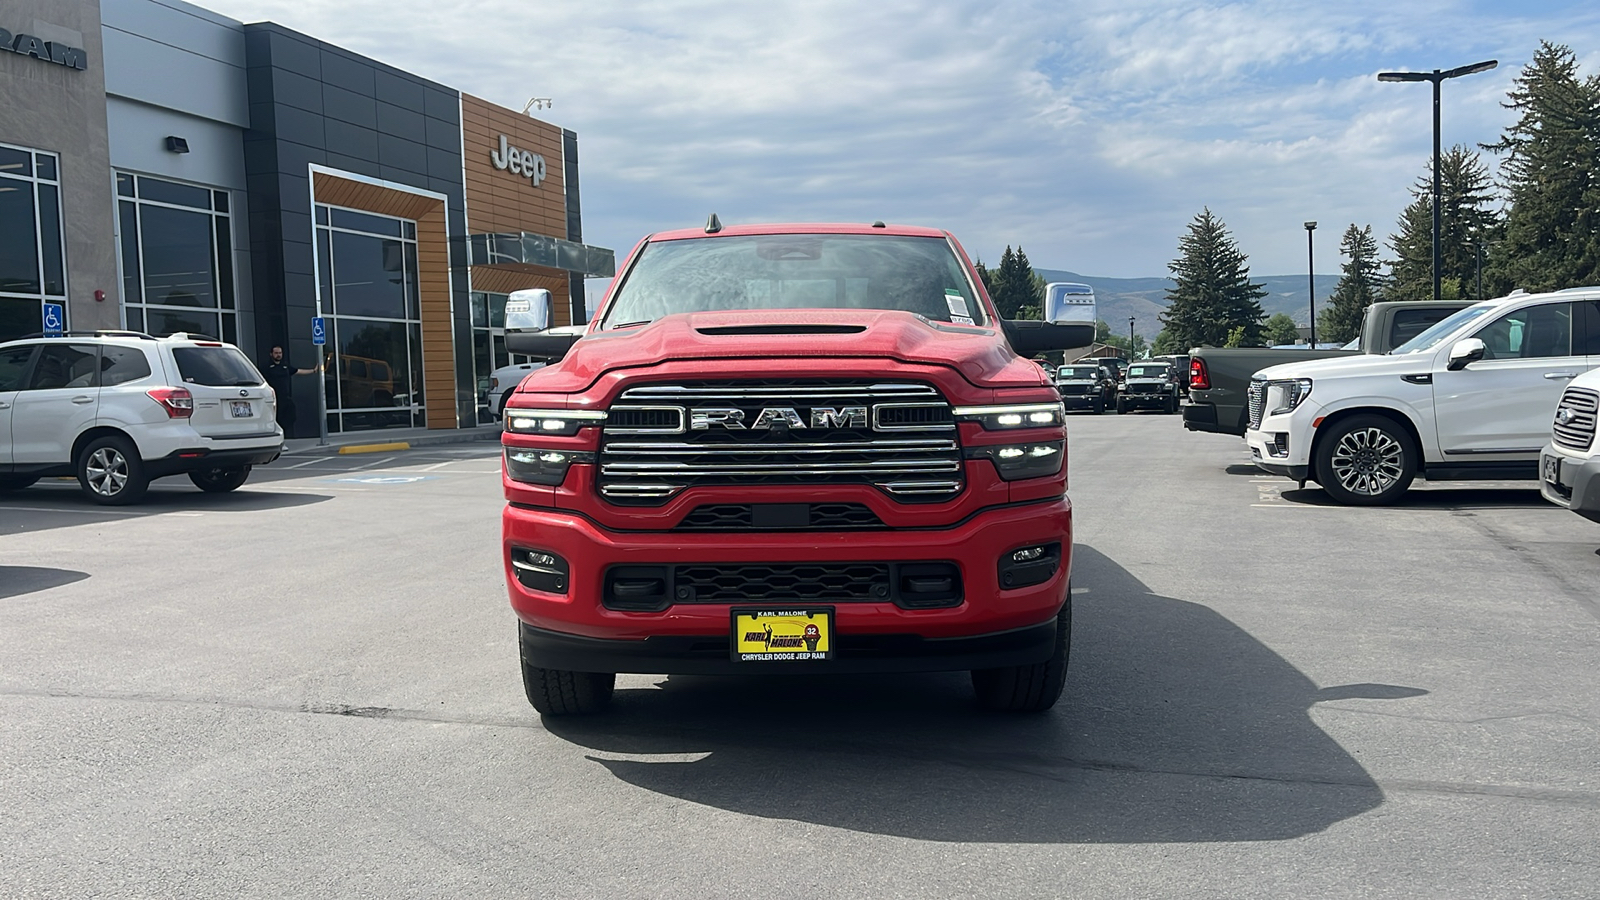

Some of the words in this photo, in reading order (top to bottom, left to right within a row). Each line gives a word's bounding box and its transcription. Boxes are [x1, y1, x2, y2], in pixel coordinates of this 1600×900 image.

[490, 134, 547, 188] Jeep
[690, 407, 868, 430] RAM
[807, 627, 816, 635] 32
[744, 632, 767, 642] KARL
[770, 638, 804, 648] MALONE
[741, 653, 773, 661] CHRYSLER
[795, 652, 811, 660] JEEP
